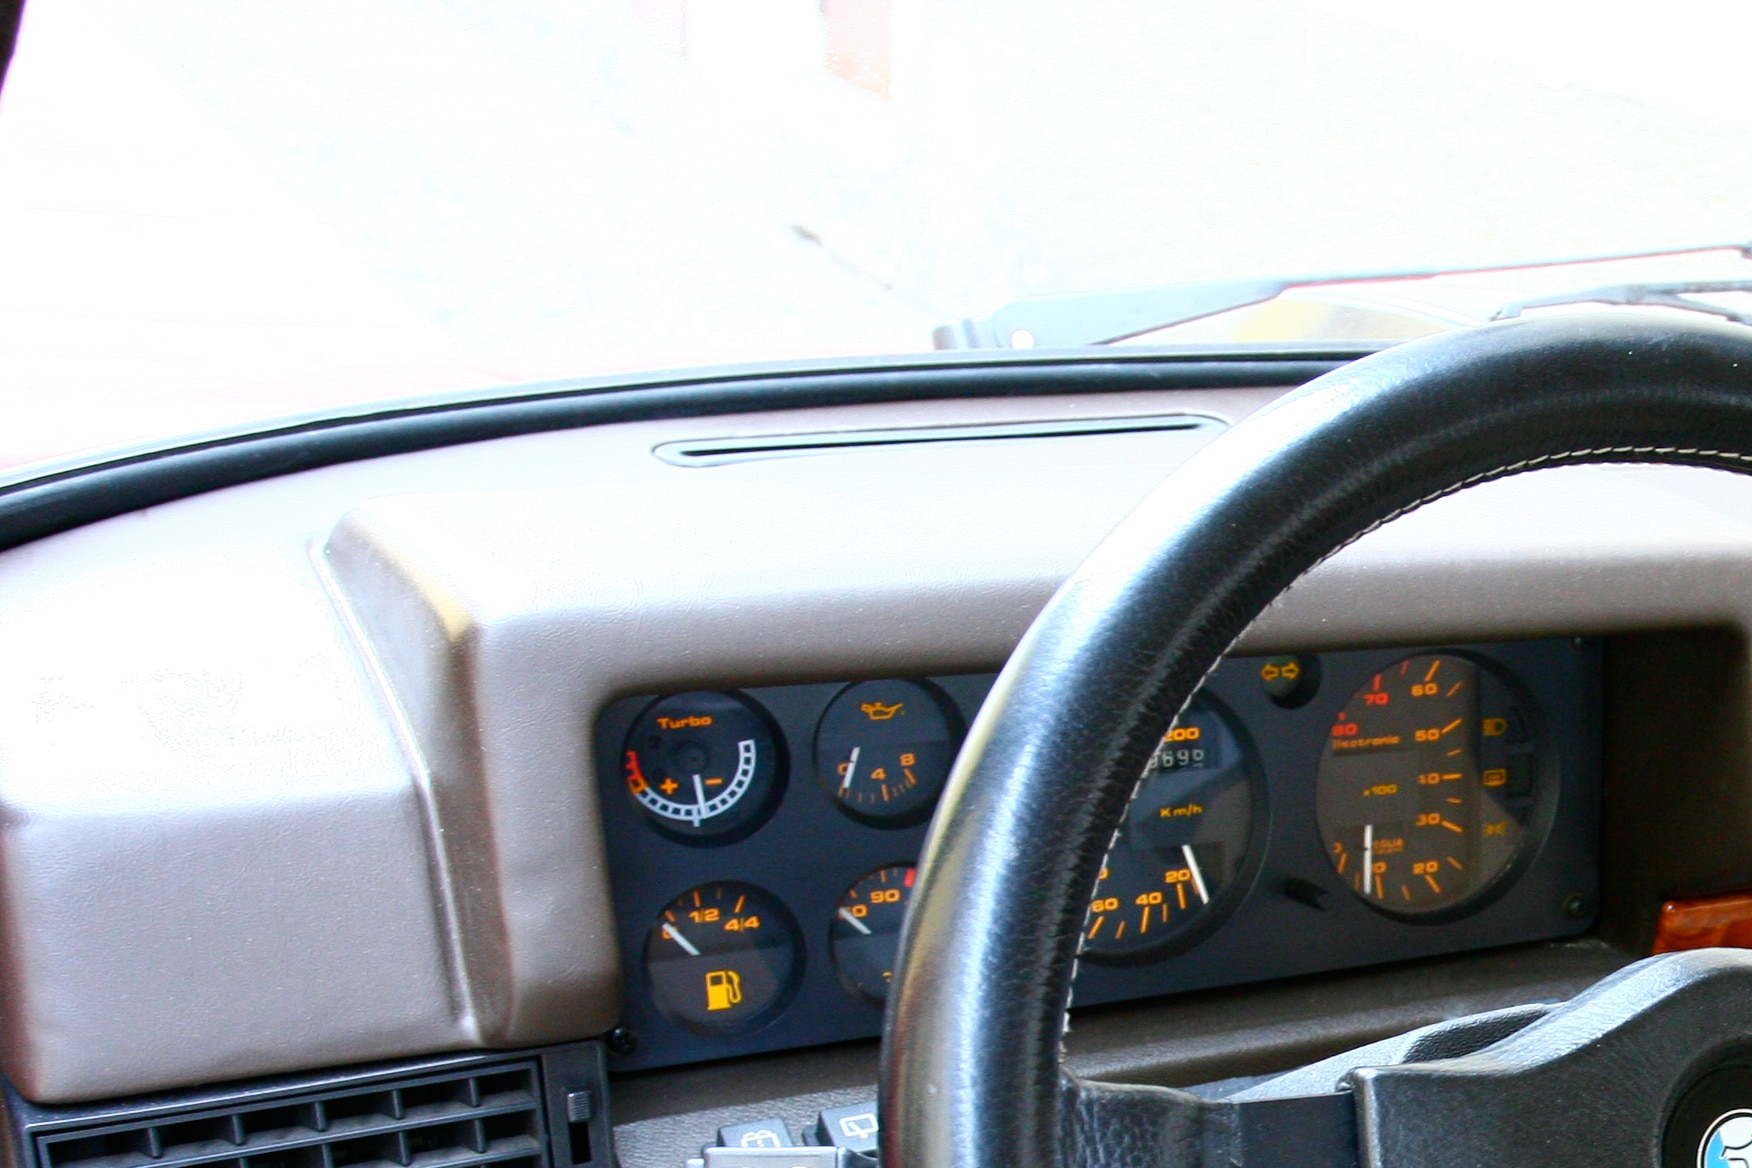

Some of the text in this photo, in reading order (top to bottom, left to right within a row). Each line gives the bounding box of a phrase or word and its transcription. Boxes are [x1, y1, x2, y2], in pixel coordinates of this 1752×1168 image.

[1410, 682, 1439, 697] 60
[1363, 691, 1390, 706] 70
[657, 716, 713, 729] Turbo
[1414, 728, 1441, 742] 50
[900, 752, 916, 767] 8
[869, 767, 887, 780] 4
[1414, 812, 1442, 827] 30
[1412, 860, 1440, 875] 20
[1164, 868, 1192, 884] 20
[869, 888, 901, 904] 90
[1135, 891, 1164, 906] 40
[1090, 897, 1119, 913] 60
